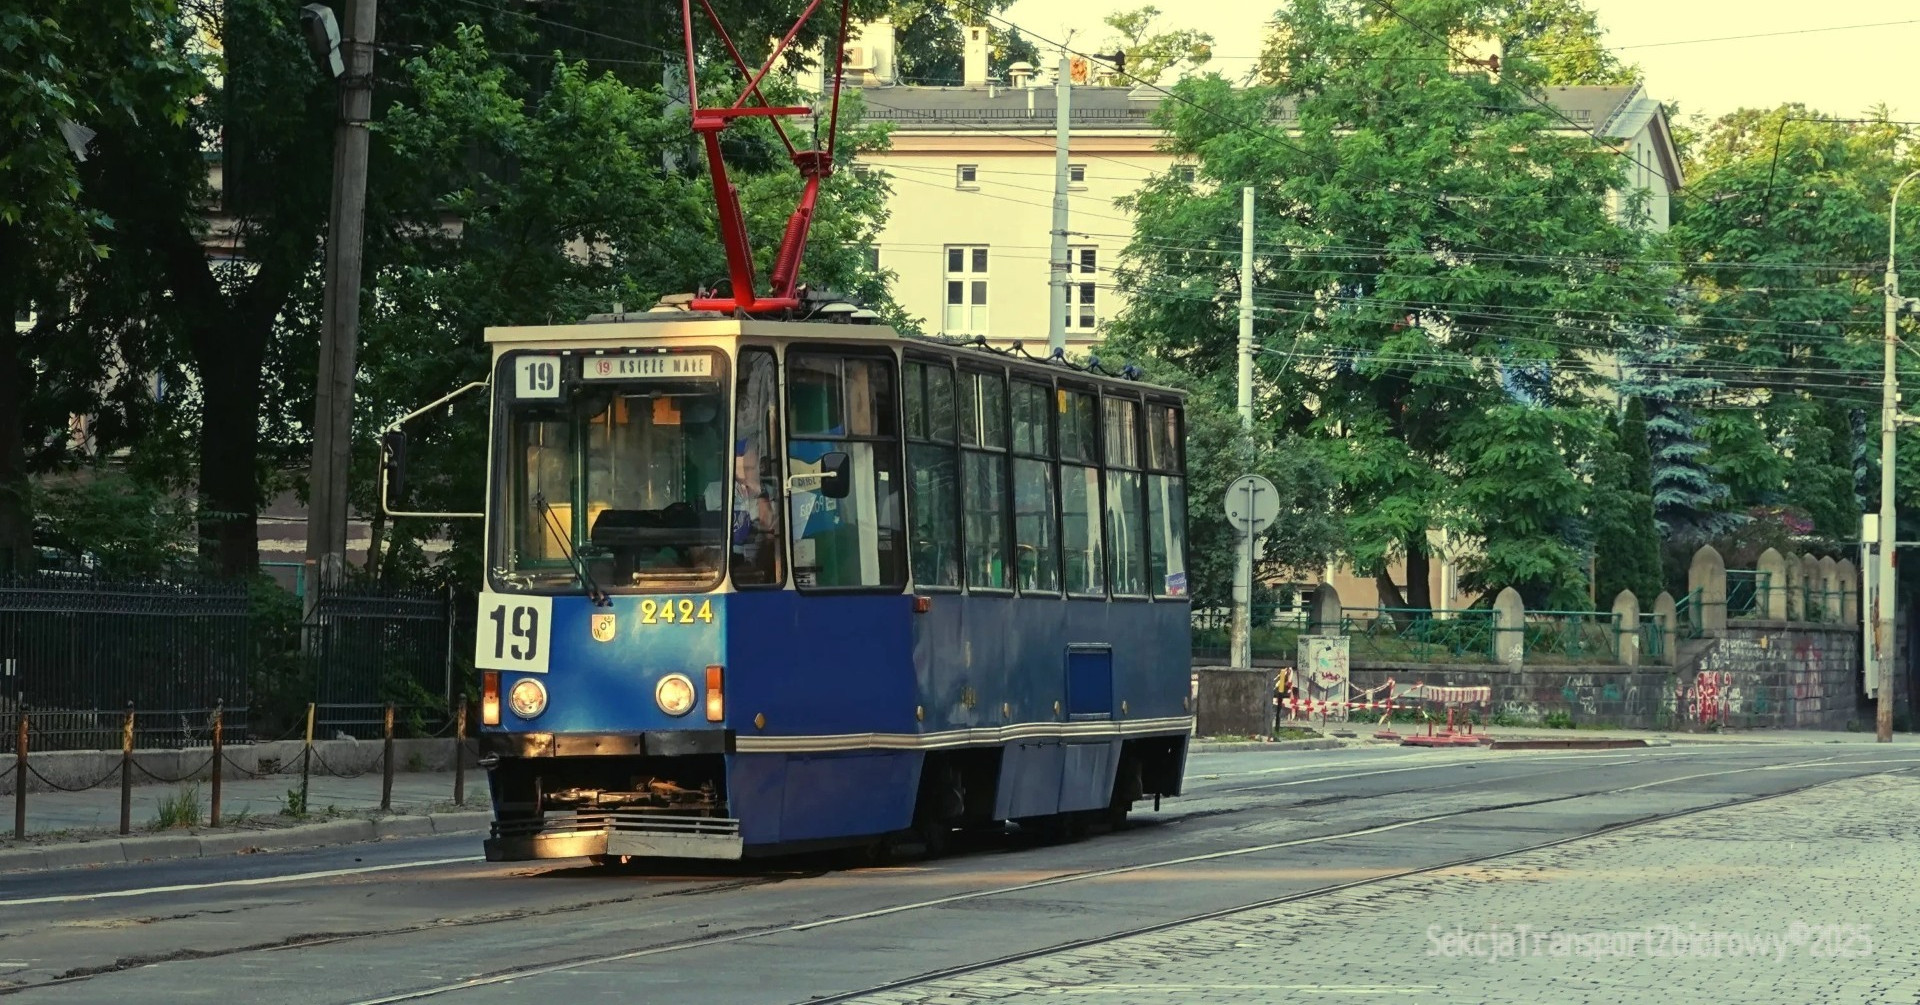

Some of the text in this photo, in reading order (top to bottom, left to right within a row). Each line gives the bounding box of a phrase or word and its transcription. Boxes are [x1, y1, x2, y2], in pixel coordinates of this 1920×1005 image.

[525, 362, 554, 391] 19
[597, 359, 704, 374] 19 KSIĘŻE MAŁE
[641, 599, 713, 624] 2424
[490, 604, 538, 660] 19
